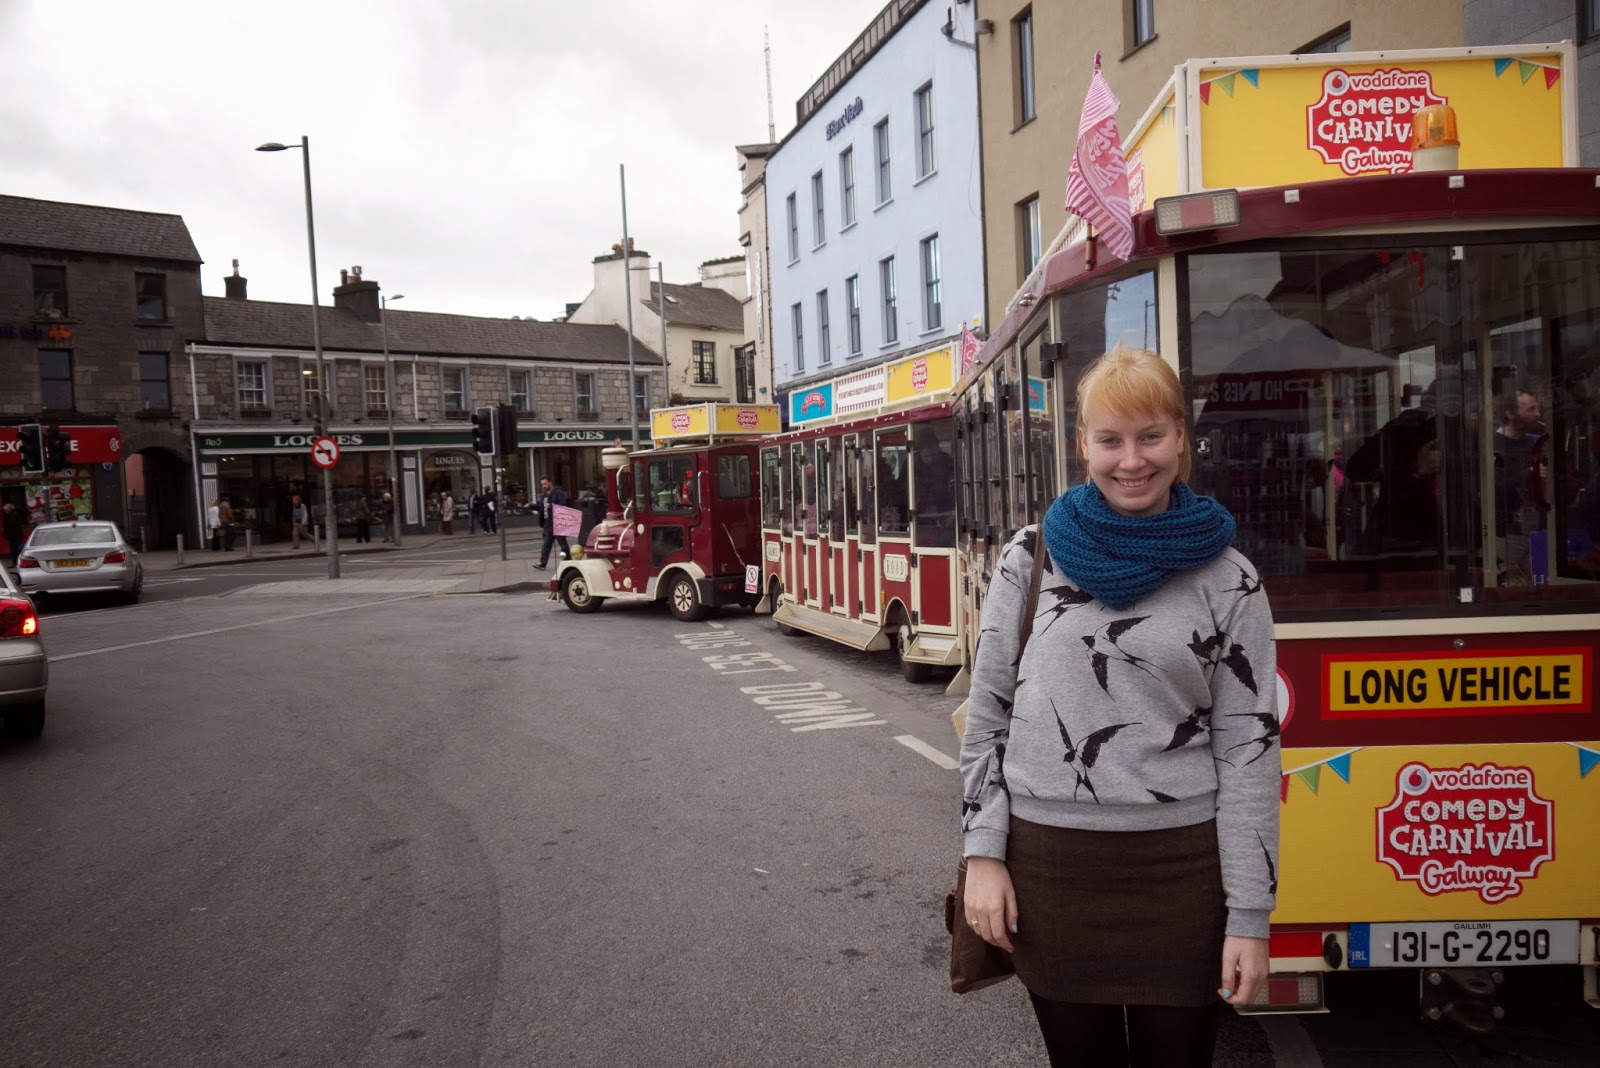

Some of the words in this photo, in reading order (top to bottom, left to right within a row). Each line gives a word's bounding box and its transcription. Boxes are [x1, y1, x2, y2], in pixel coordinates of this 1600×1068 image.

[1351, 73, 1427, 88] vodafone
[1328, 95, 1426, 117] COMEDY
[1317, 116, 1413, 144] CARNIV
[273, 434, 363, 447] LOES
[543, 431, 604, 441] LOGUES
[435, 456, 465, 465] LOGUES
[674, 630, 752, 650] BUS
[702, 652, 798, 675] SET
[1343, 669, 1428, 704] LONG
[1437, 665, 1572, 702] VEHICLE
[740, 681, 888, 733] DOWN
[1433, 769, 1528, 786] vodafone
[1404, 798, 1526, 822] COMEDY
[1389, 821, 1543, 857] CARNIVAL
[1423, 863, 1517, 897] Galway
[1352, 951, 1367, 961] IRL
[1393, 929, 1550, 963] 131-G-2290
